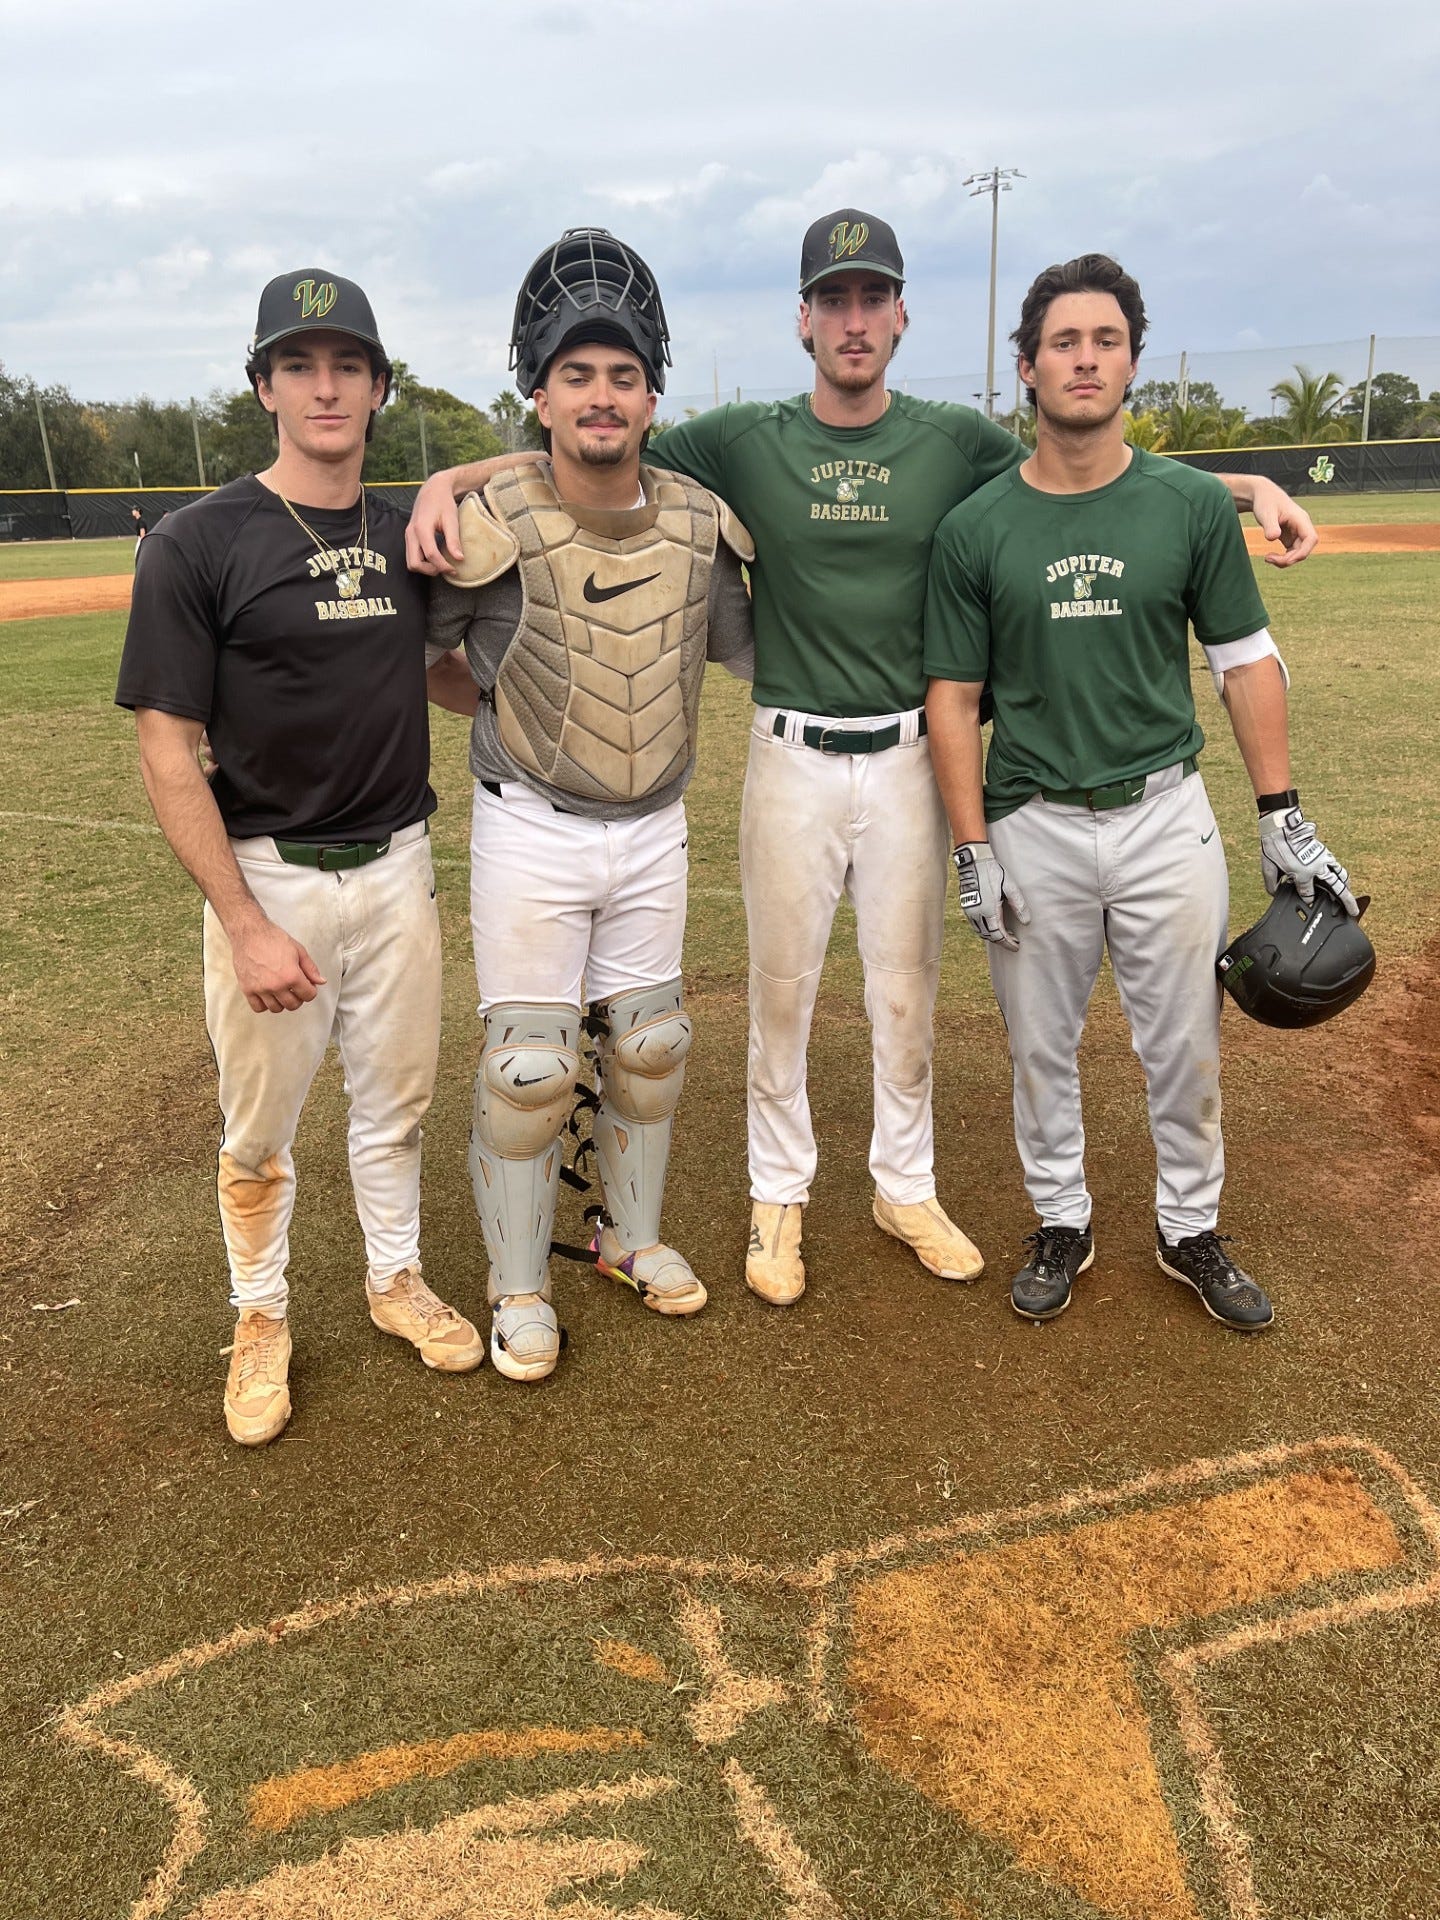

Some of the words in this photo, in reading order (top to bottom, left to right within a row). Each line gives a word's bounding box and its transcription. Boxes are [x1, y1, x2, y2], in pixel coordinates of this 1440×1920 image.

[828, 221, 869, 260] W
[293, 279, 338, 318] W
[810, 459, 891, 485] JUPITER
[810, 503, 889, 522] BASEBALL
[306, 547, 387, 578] JUPITER
[1046, 554, 1125, 583] JUPITER
[1050, 599, 1123, 619] BASEBALL
